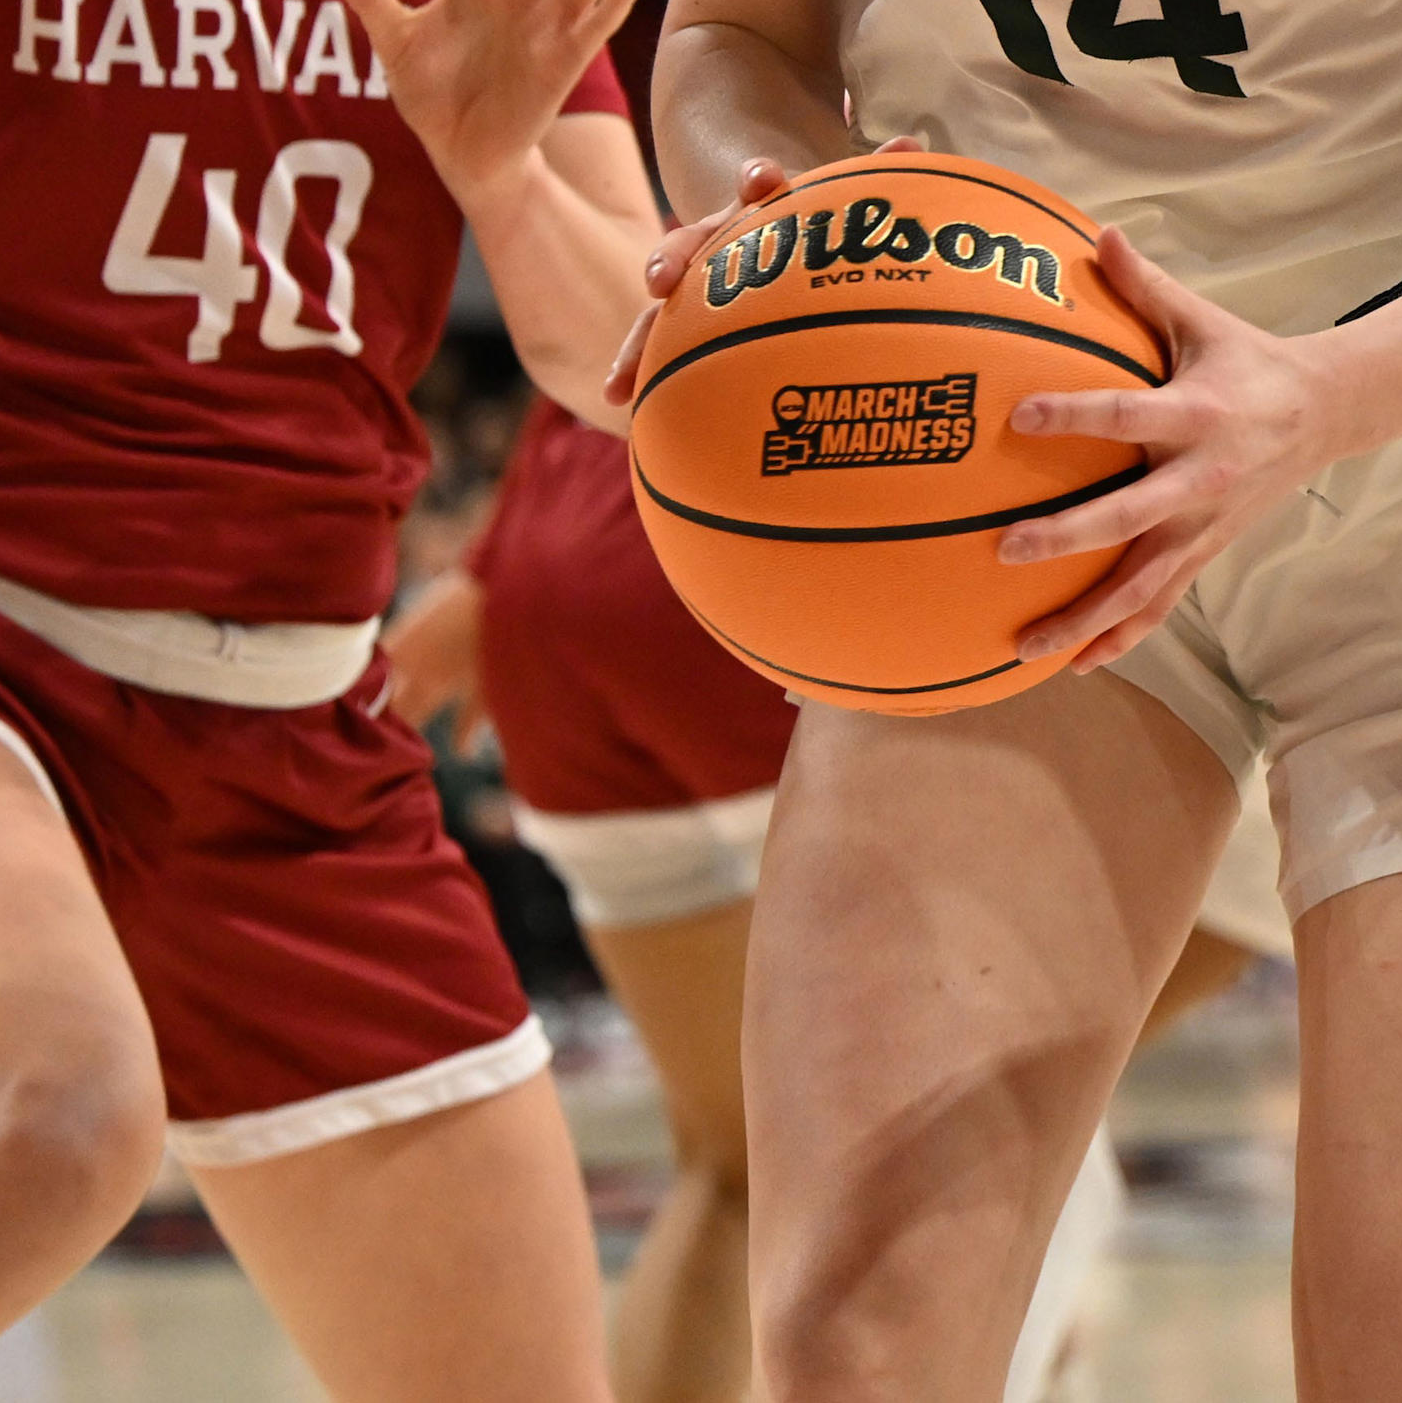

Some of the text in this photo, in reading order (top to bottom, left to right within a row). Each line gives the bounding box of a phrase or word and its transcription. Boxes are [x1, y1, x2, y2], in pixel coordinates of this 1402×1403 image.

[102, 133, 373, 363] 40
[704, 197, 1064, 309] Wilson
[810, 269, 932, 289] EVO NXT
[806, 386, 918, 422] MARCH
[819, 417, 972, 455] MADNESS
